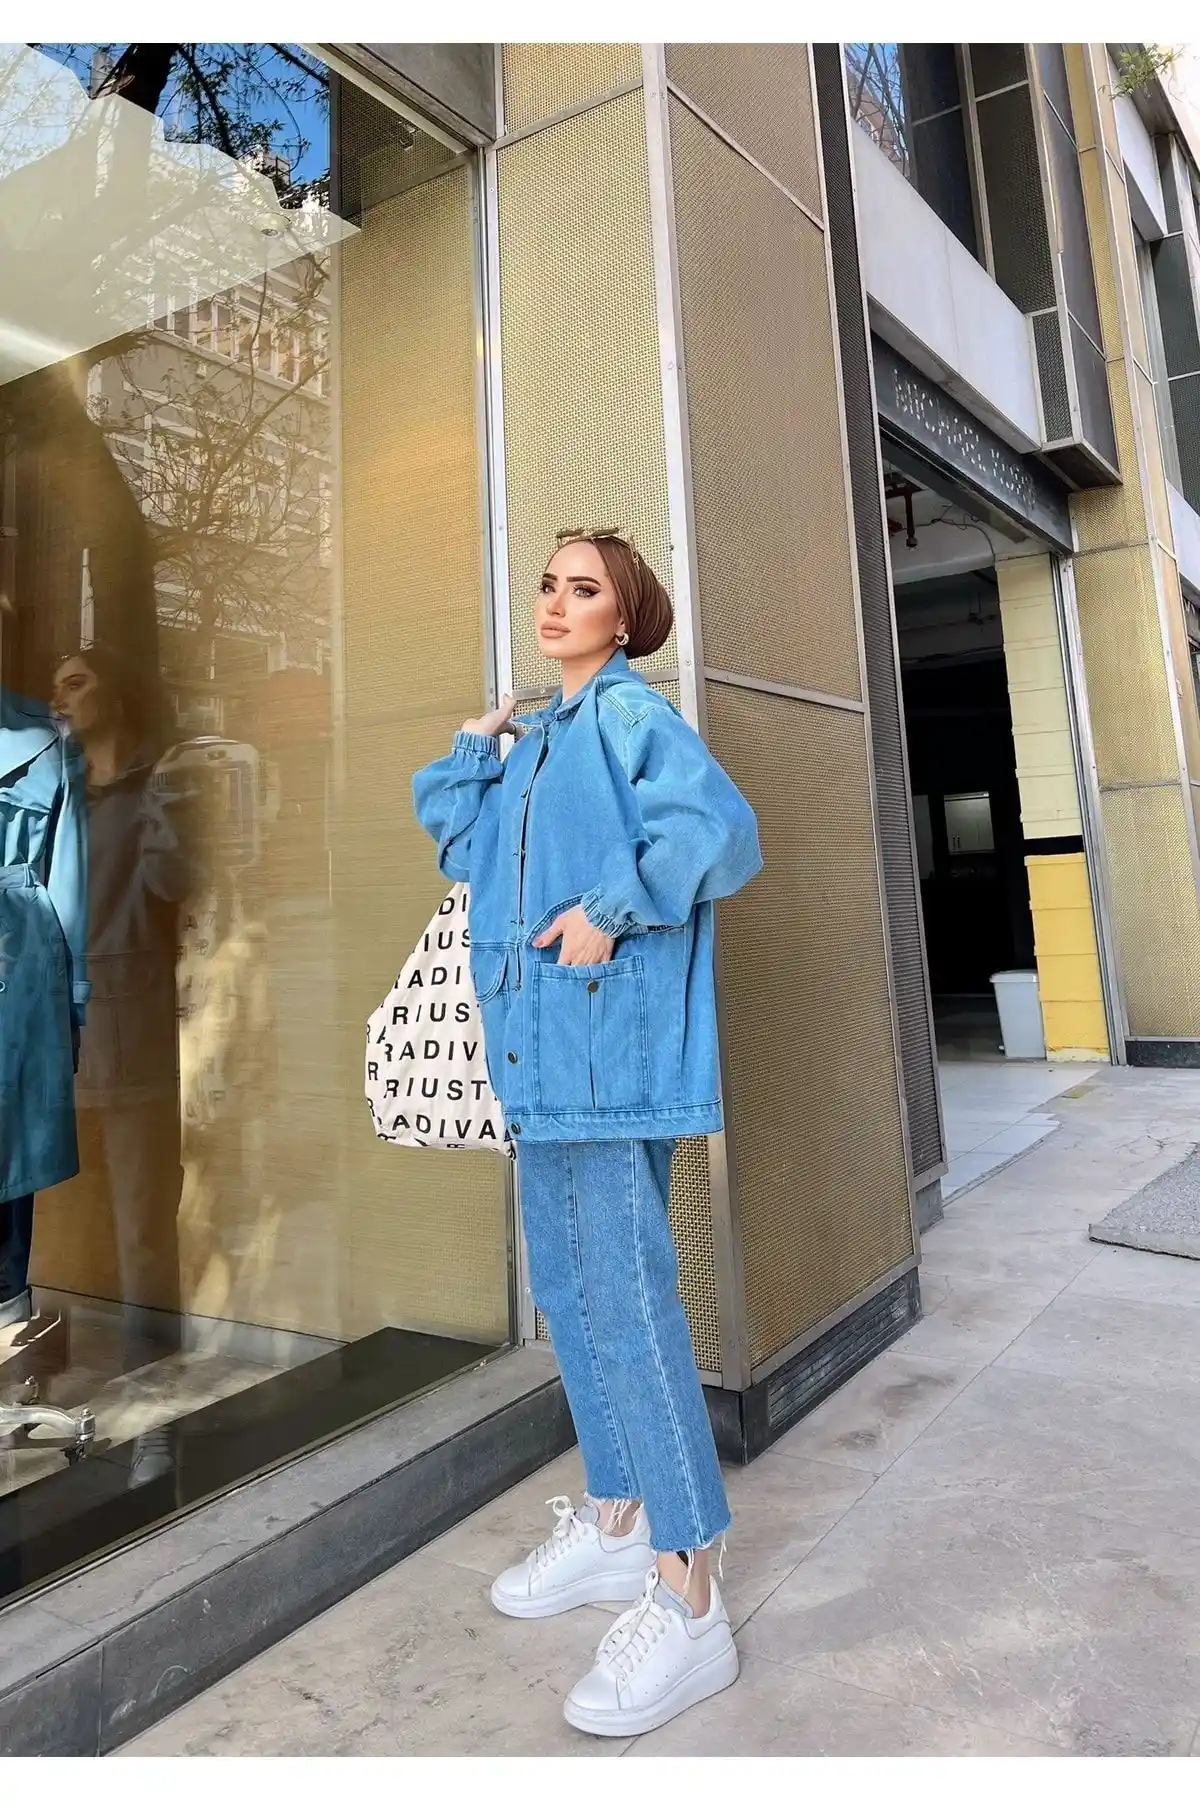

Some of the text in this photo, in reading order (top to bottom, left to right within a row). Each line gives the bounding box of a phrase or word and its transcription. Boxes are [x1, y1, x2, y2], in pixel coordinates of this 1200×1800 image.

[438, 893, 467, 915] DI
[392, 1002, 480, 1025] RIUS
[384, 1077, 497, 1100] RIUST
[377, 1114, 497, 1139] ADIVA
